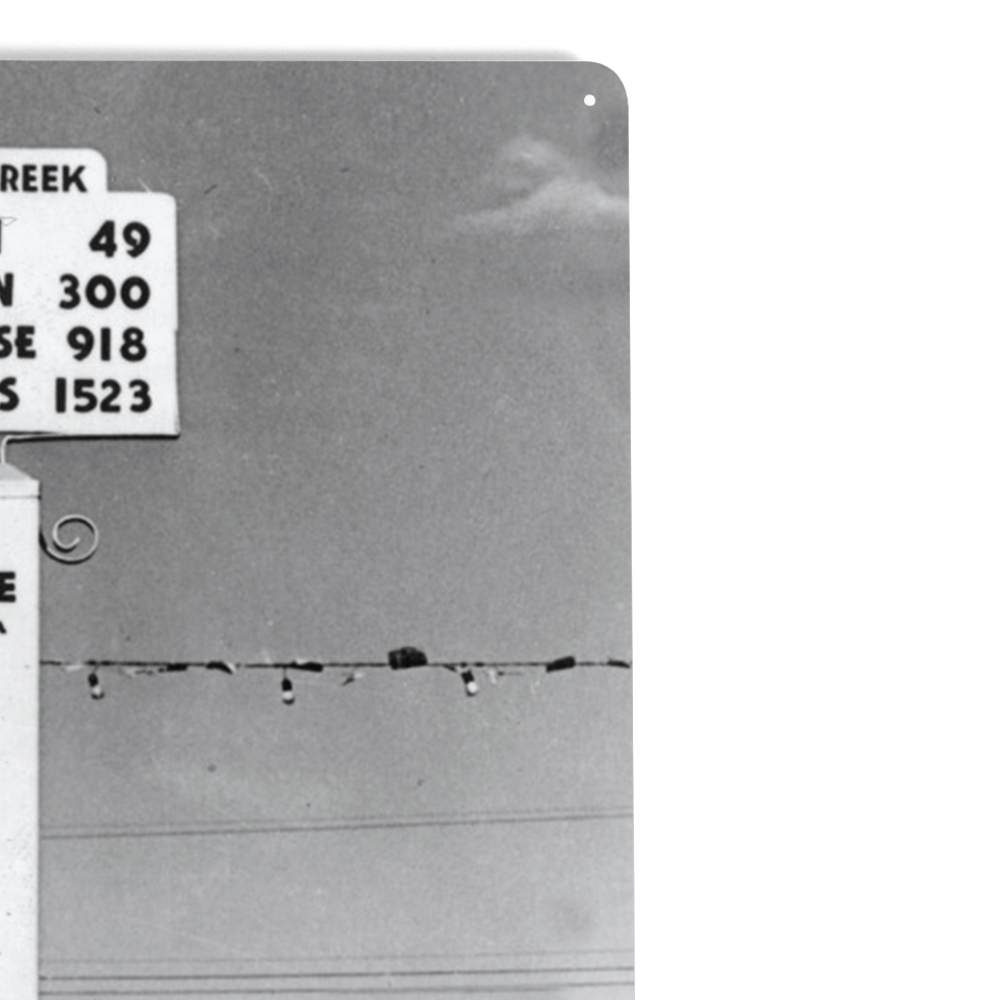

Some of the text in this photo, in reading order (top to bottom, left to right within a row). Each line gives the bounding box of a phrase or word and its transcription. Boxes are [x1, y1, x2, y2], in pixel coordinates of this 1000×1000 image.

[88, 220, 151, 258] 49
[59, 274, 151, 310] 300
[67, 326, 147, 362] 918
[55, 378, 152, 414] 1523
